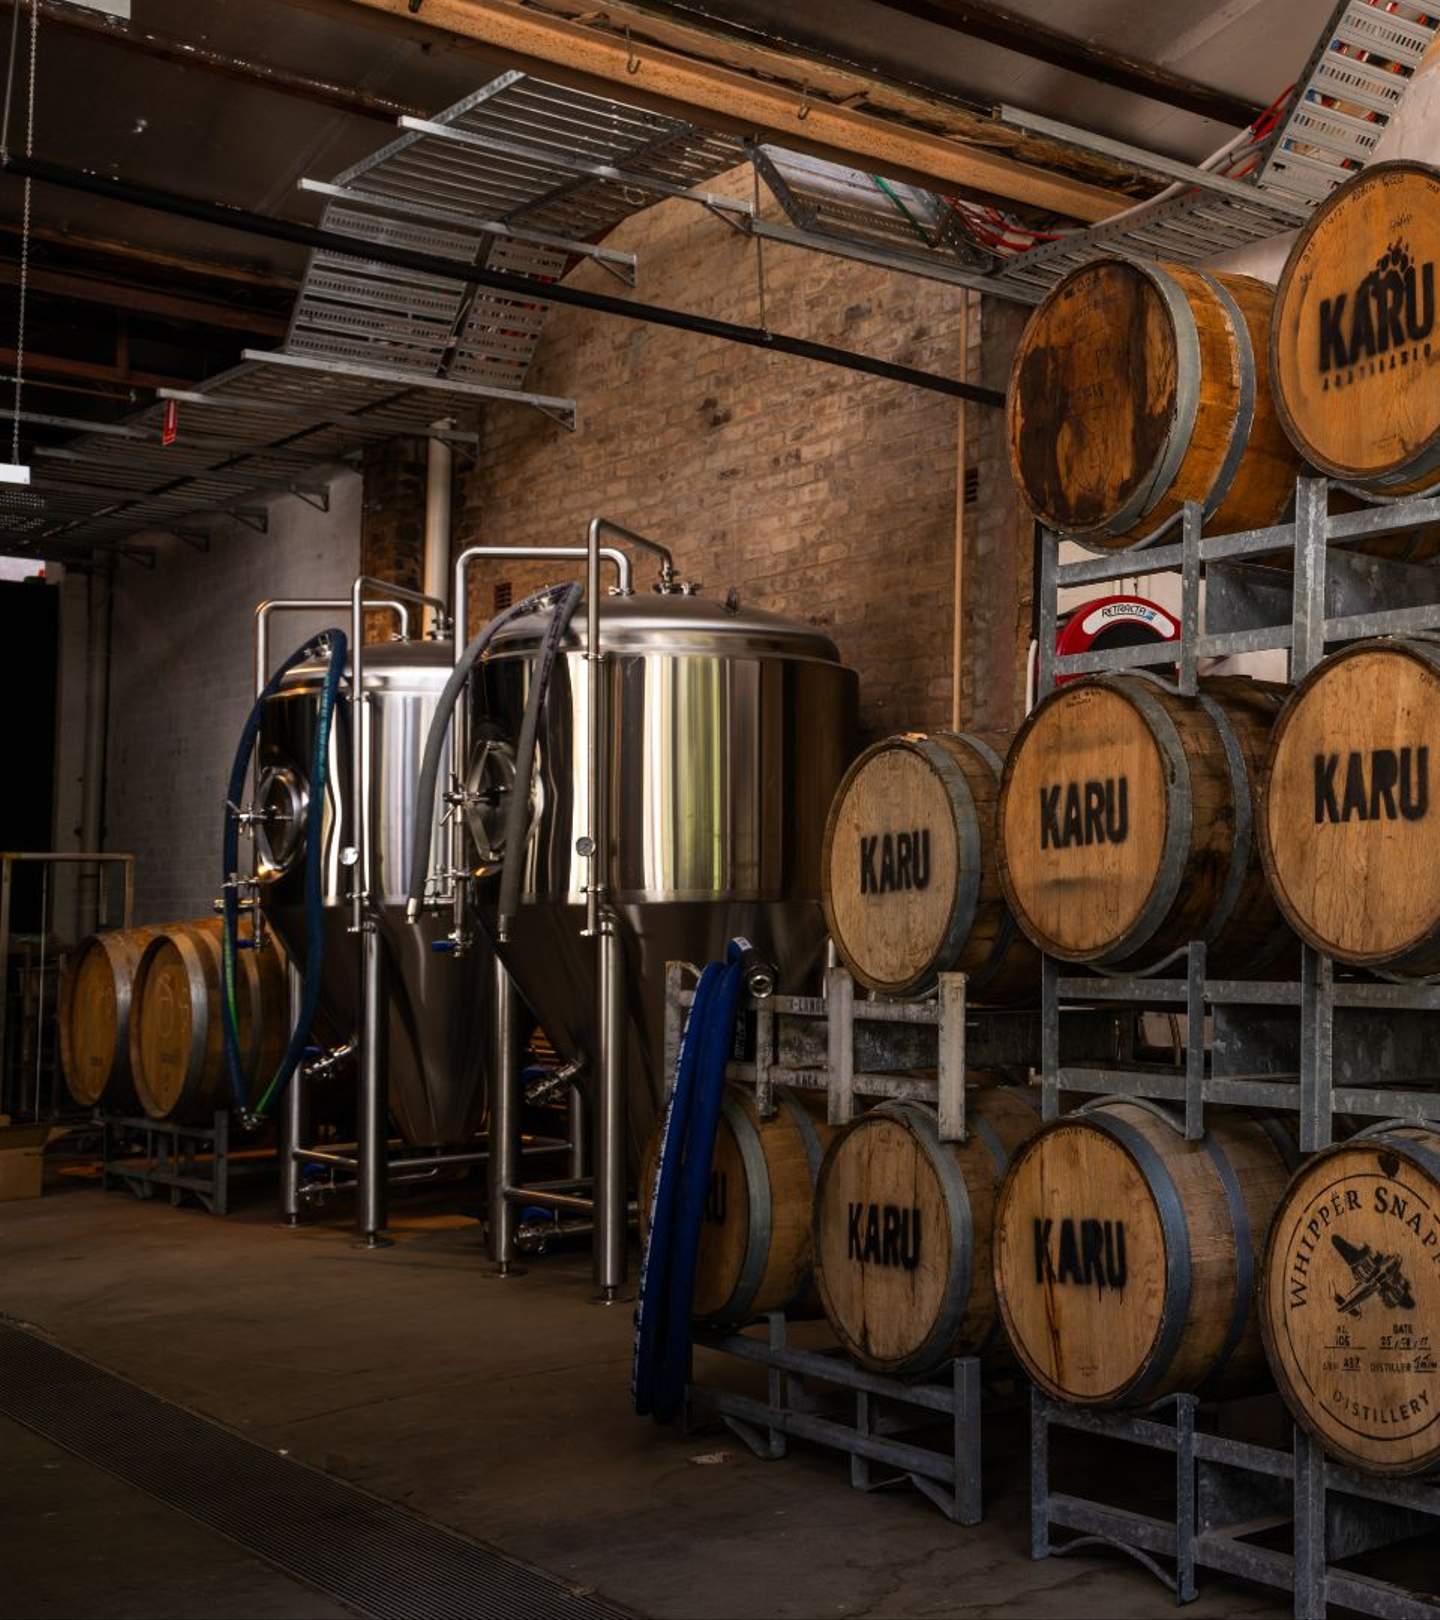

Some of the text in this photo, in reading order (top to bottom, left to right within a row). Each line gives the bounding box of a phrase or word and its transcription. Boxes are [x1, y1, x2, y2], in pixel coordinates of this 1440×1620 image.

[1317, 262, 1434, 373] KARU
[1040, 776, 1129, 851] KARU
[1314, 746, 1429, 824] KARU
[860, 829, 930, 895] KARU
[848, 1202, 922, 1271] KARU
[1034, 1218, 1128, 1289] KARU
[1291, 1189, 1363, 1312] WHIPPER
[1333, 1389, 1429, 1424] DISTILLERY
